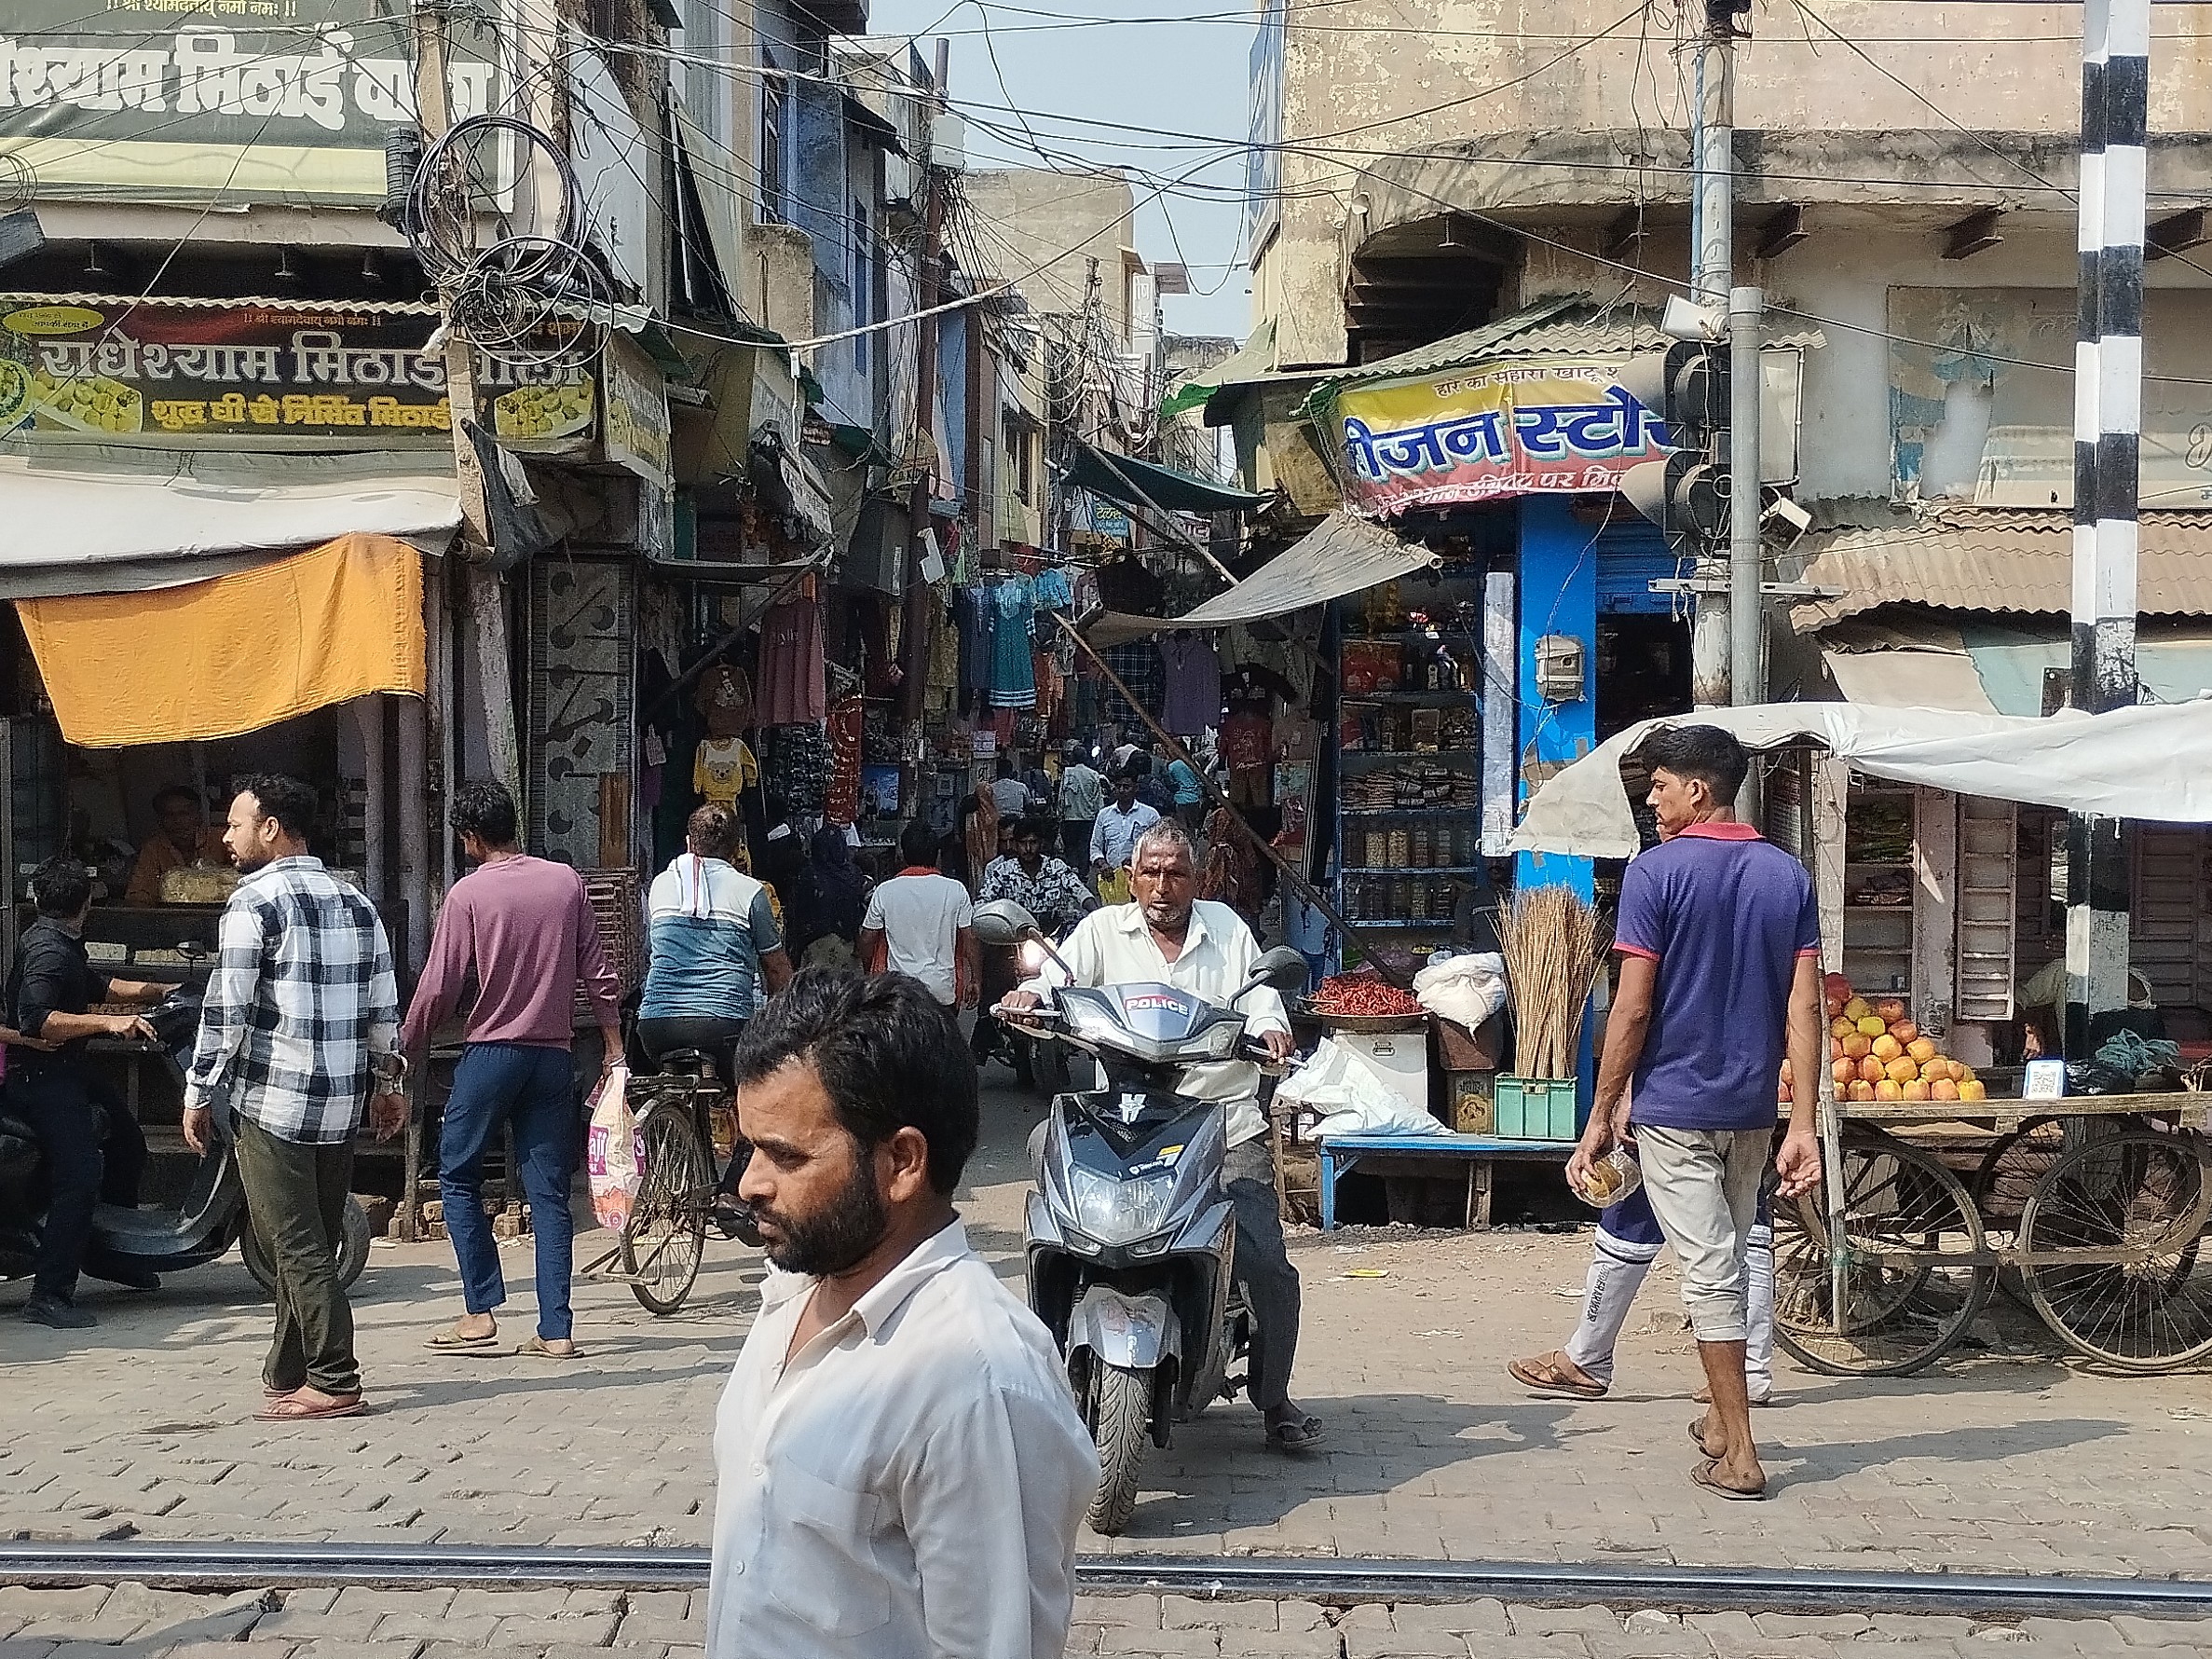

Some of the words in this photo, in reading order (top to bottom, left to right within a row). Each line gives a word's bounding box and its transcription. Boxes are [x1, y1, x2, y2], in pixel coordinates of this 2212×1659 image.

[0, 35, 171, 112] श्याम
[173, 30, 355, 131] मिठाई
[38, 326, 281, 382] राधेश्याम
[1434, 378, 1462, 398] हारे
[1465, 375, 1488, 390] का
[1491, 368, 1548, 383] सहारा
[1551, 366, 1604, 383] खाटू
[1539, 471, 1577, 487] पर
[1125, 997, 1189, 1017] POLICE
